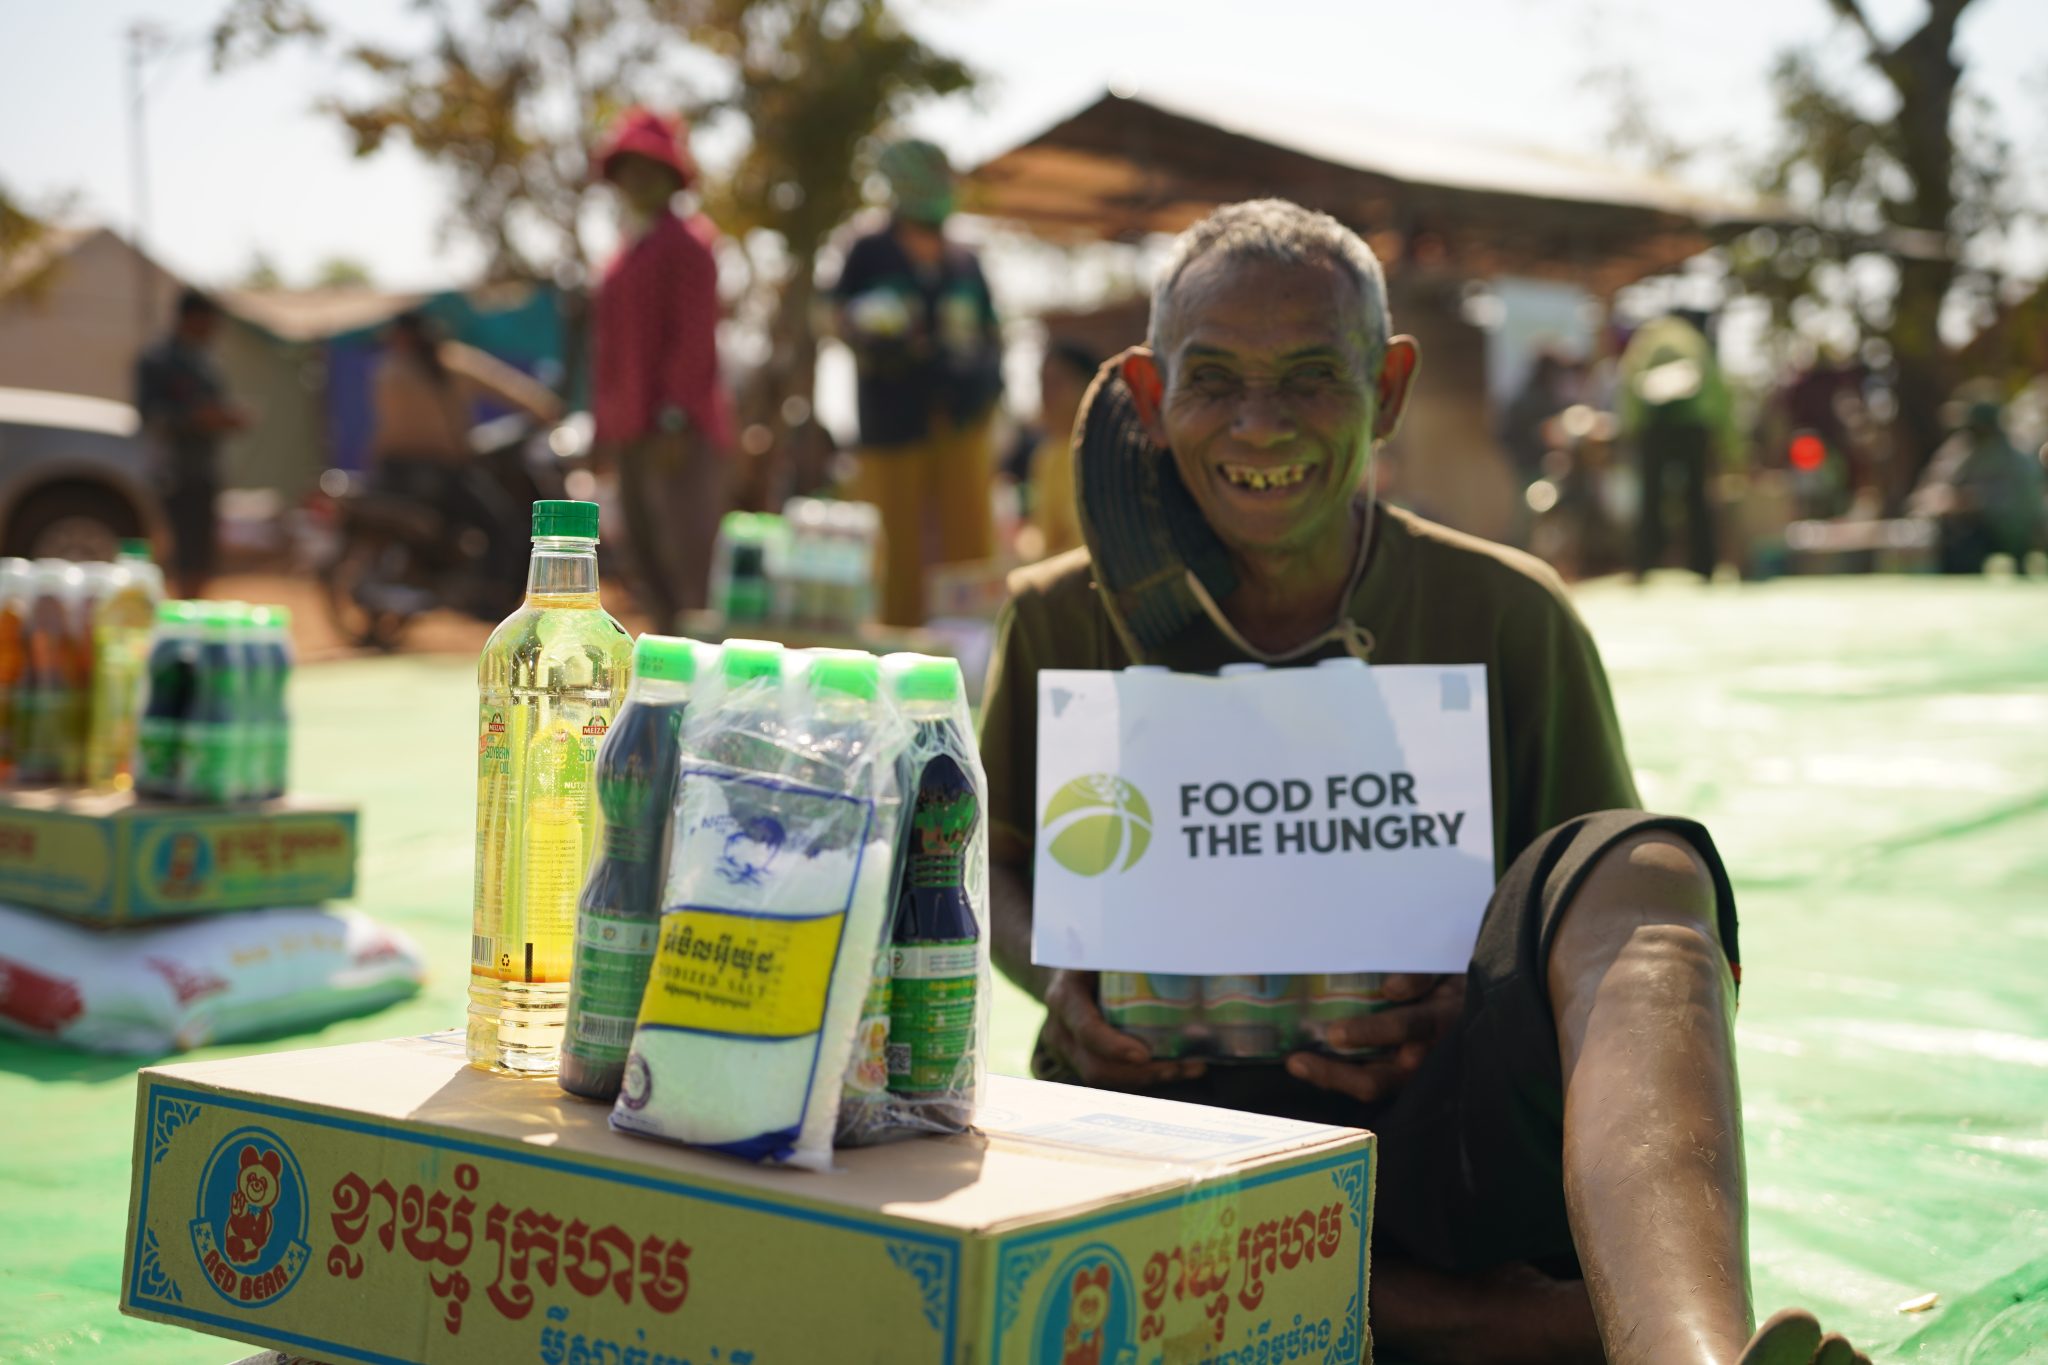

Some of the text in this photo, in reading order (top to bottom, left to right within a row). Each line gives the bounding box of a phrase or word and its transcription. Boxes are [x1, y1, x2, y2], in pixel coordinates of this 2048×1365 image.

[486, 745, 510, 760] SOYBEAN
[583, 726, 609, 735] MEIZA
[1180, 772, 1417, 817] FOOD FOR
[1182, 811, 1465, 858] THE HUNGRY
[203, 1249, 288, 1301] RED BEAR
